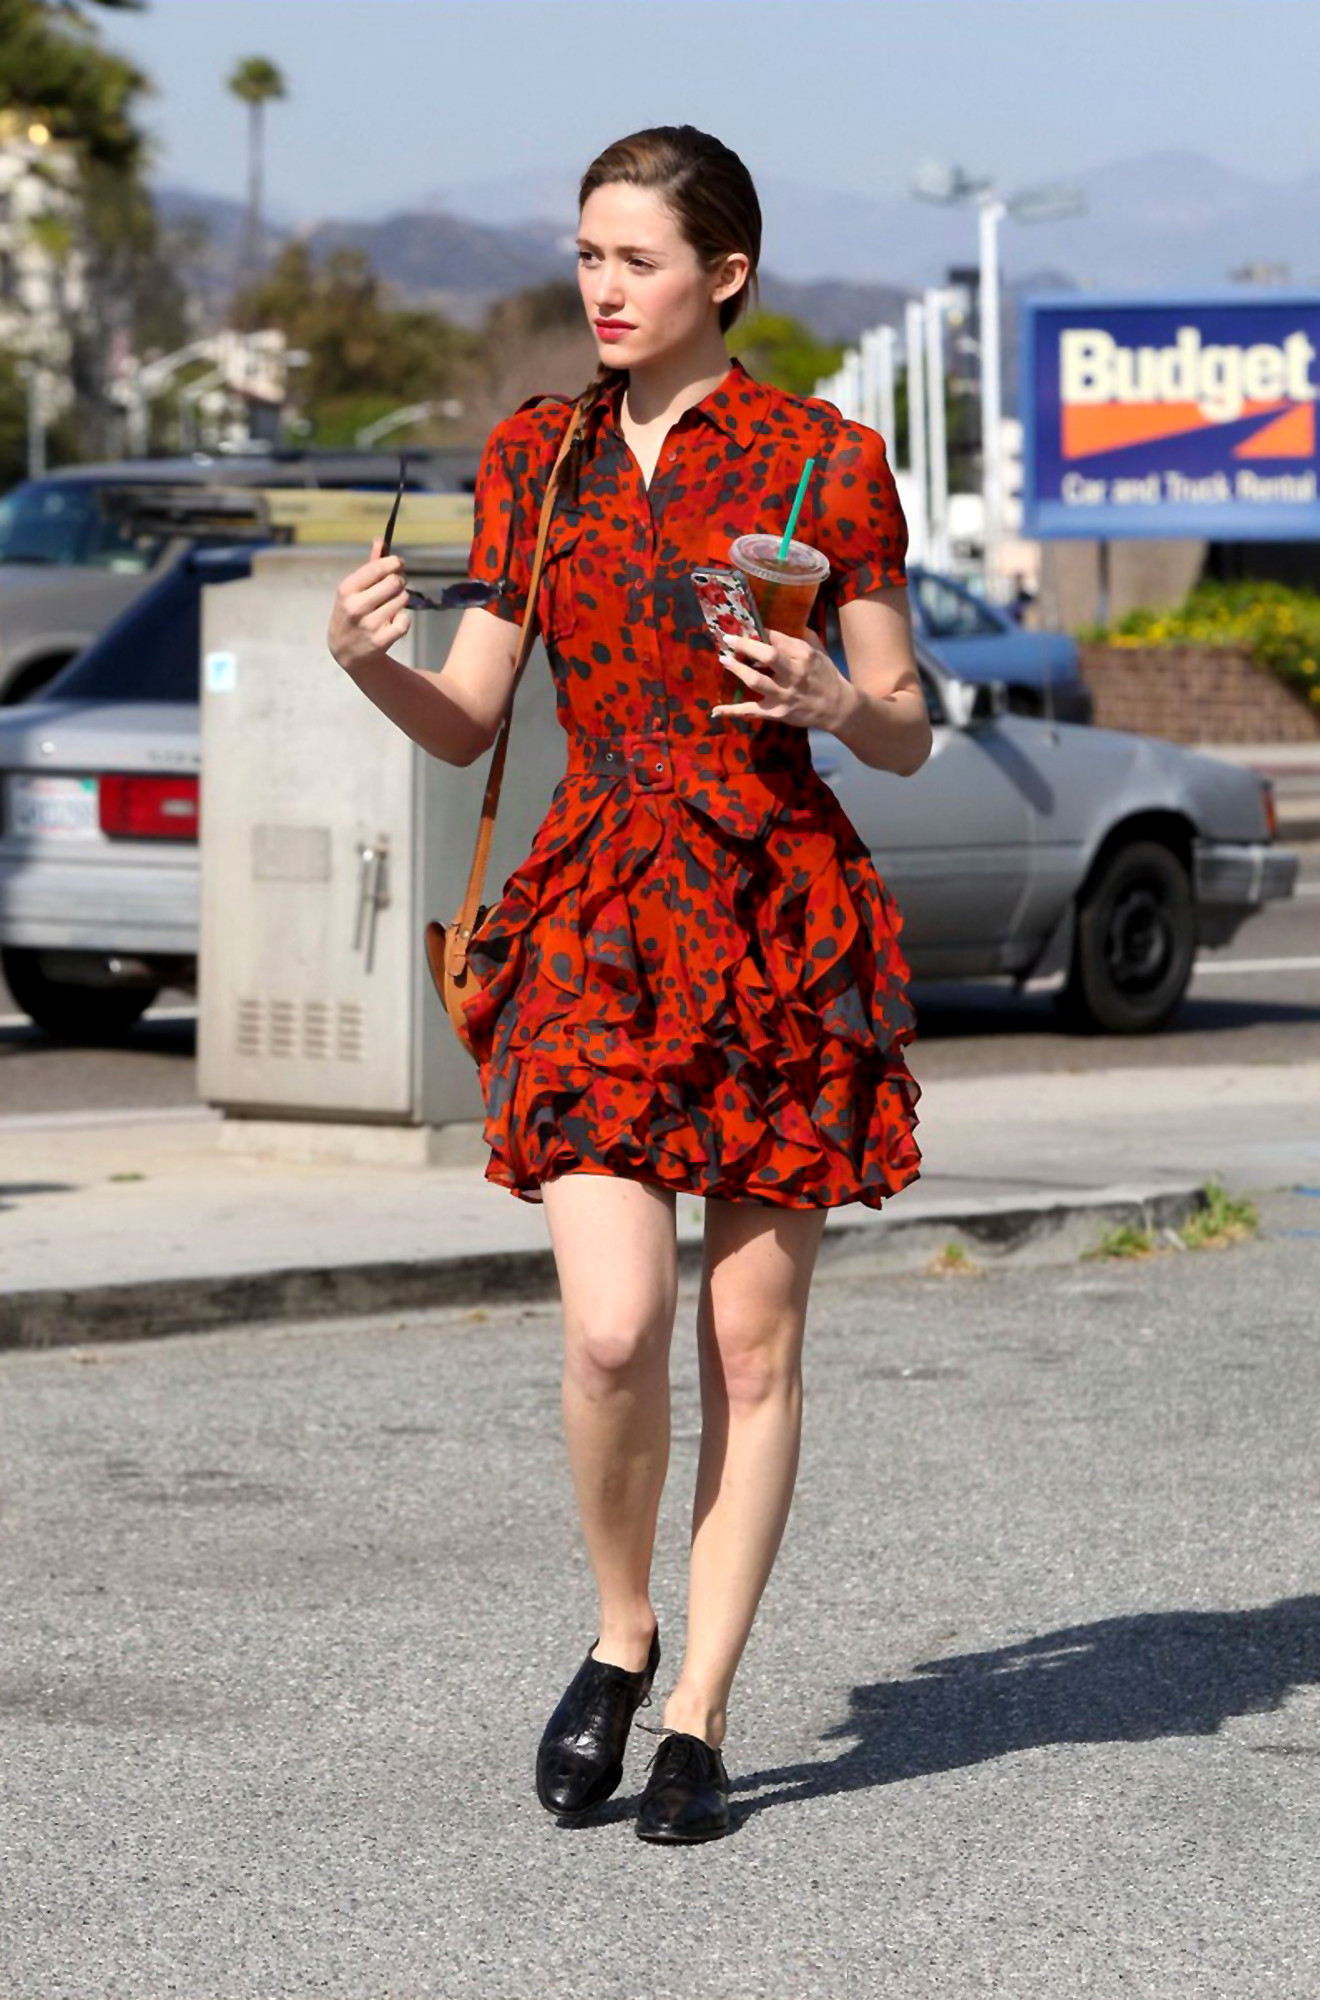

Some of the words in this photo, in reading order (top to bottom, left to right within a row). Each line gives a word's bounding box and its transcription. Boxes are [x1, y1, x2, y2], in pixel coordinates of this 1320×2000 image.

[1060, 326, 1319, 423] Budget
[1061, 471, 1107, 504] Car
[1110, 471, 1160, 504] and
[1162, 470, 1232, 503] Truck
[1235, 469, 1316, 502] Rental
